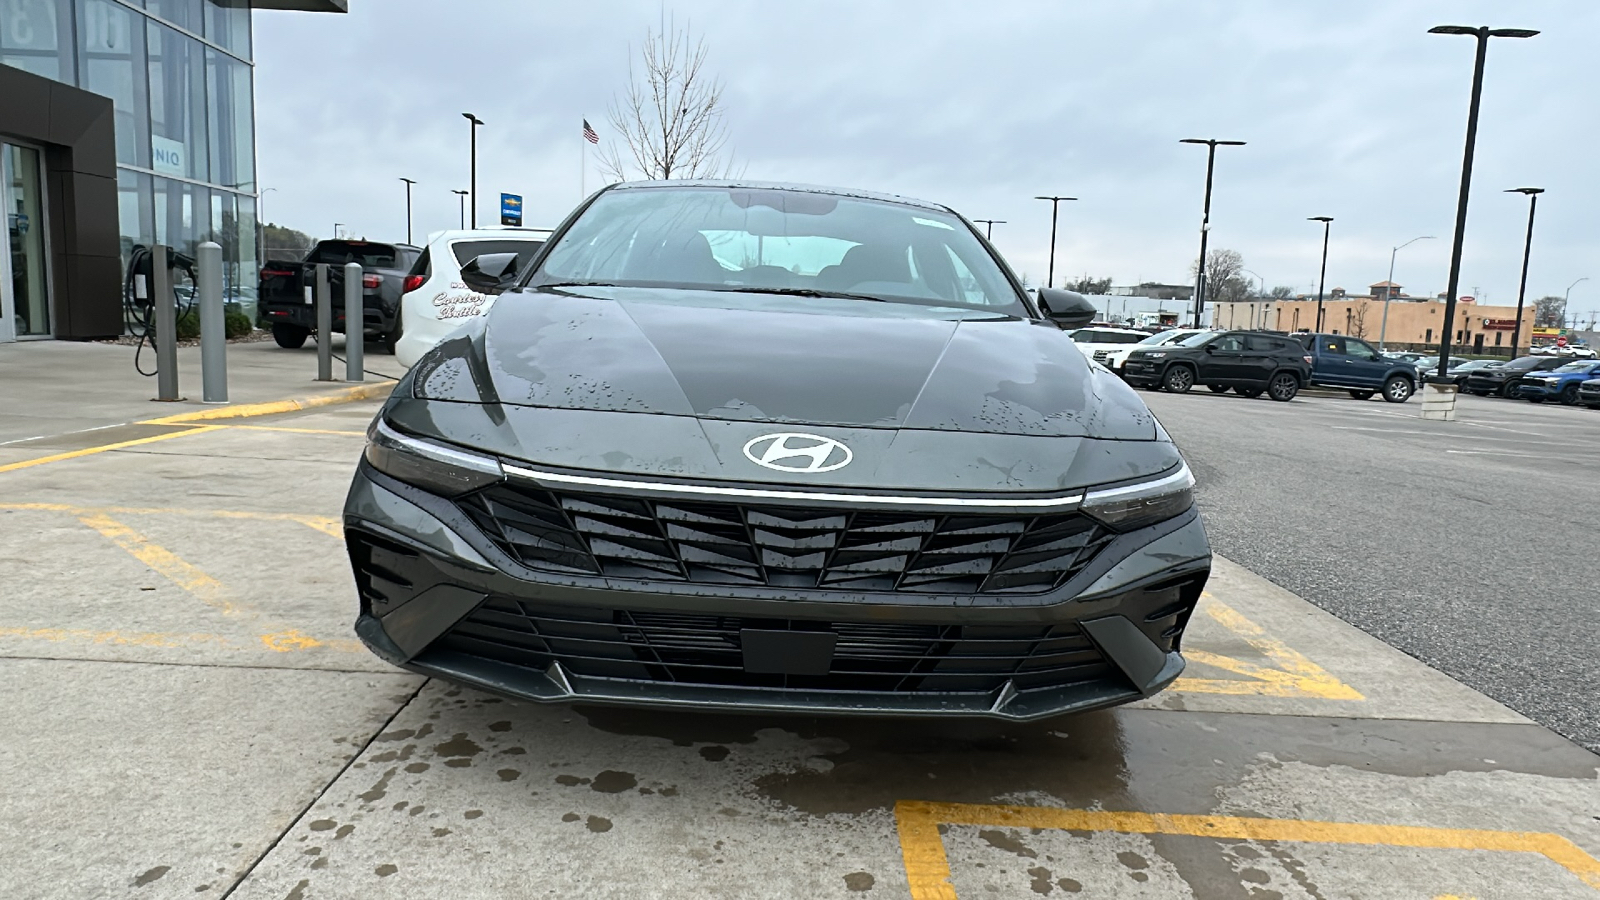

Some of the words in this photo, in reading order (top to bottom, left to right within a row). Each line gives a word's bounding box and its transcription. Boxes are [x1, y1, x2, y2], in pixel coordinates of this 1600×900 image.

[154, 148, 180, 166] NIQ
[433, 292, 486, 306] Courtesy
[436, 305, 481, 320] Shuttle
